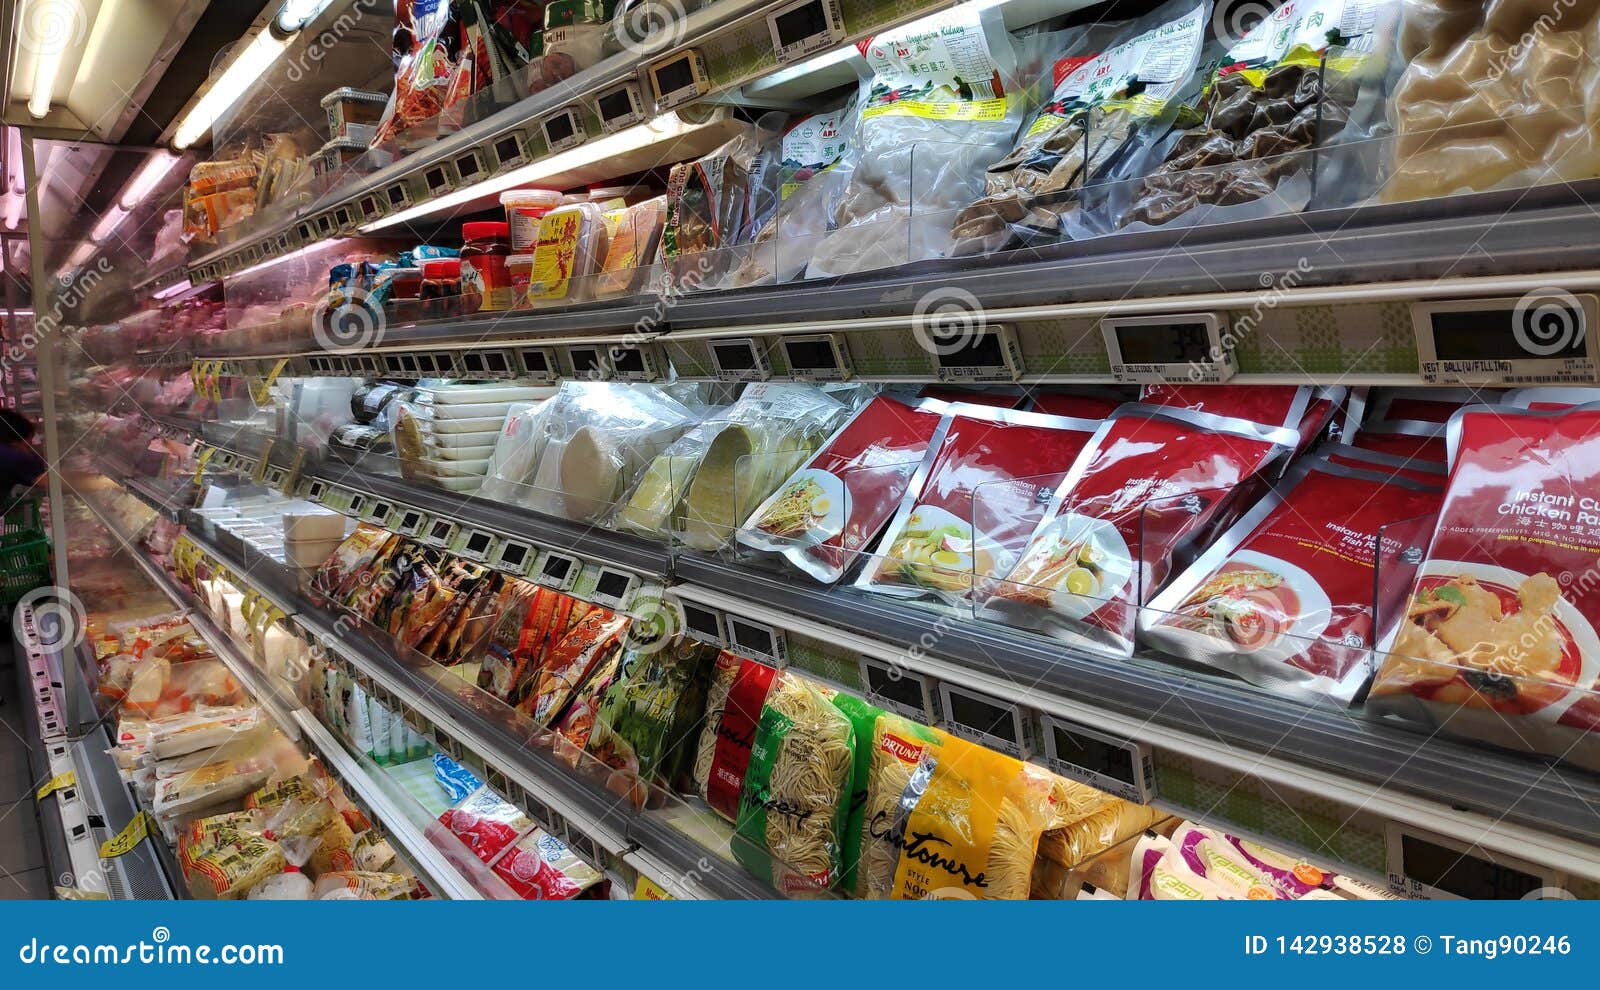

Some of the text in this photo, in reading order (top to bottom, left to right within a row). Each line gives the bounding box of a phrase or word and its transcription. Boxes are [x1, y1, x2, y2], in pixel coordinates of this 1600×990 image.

[1514, 490, 1575, 507] Instant
[1497, 503, 1600, 526] Chicken Pa
[1325, 522, 1363, 540] Instant
[1341, 535, 1363, 547] Fish
[1579, 538, 1600, 547] TRAN
[882, 737, 924, 760] ORTUNE
[870, 810, 988, 888] Cantonese
[907, 869, 930, 886] STYLE
